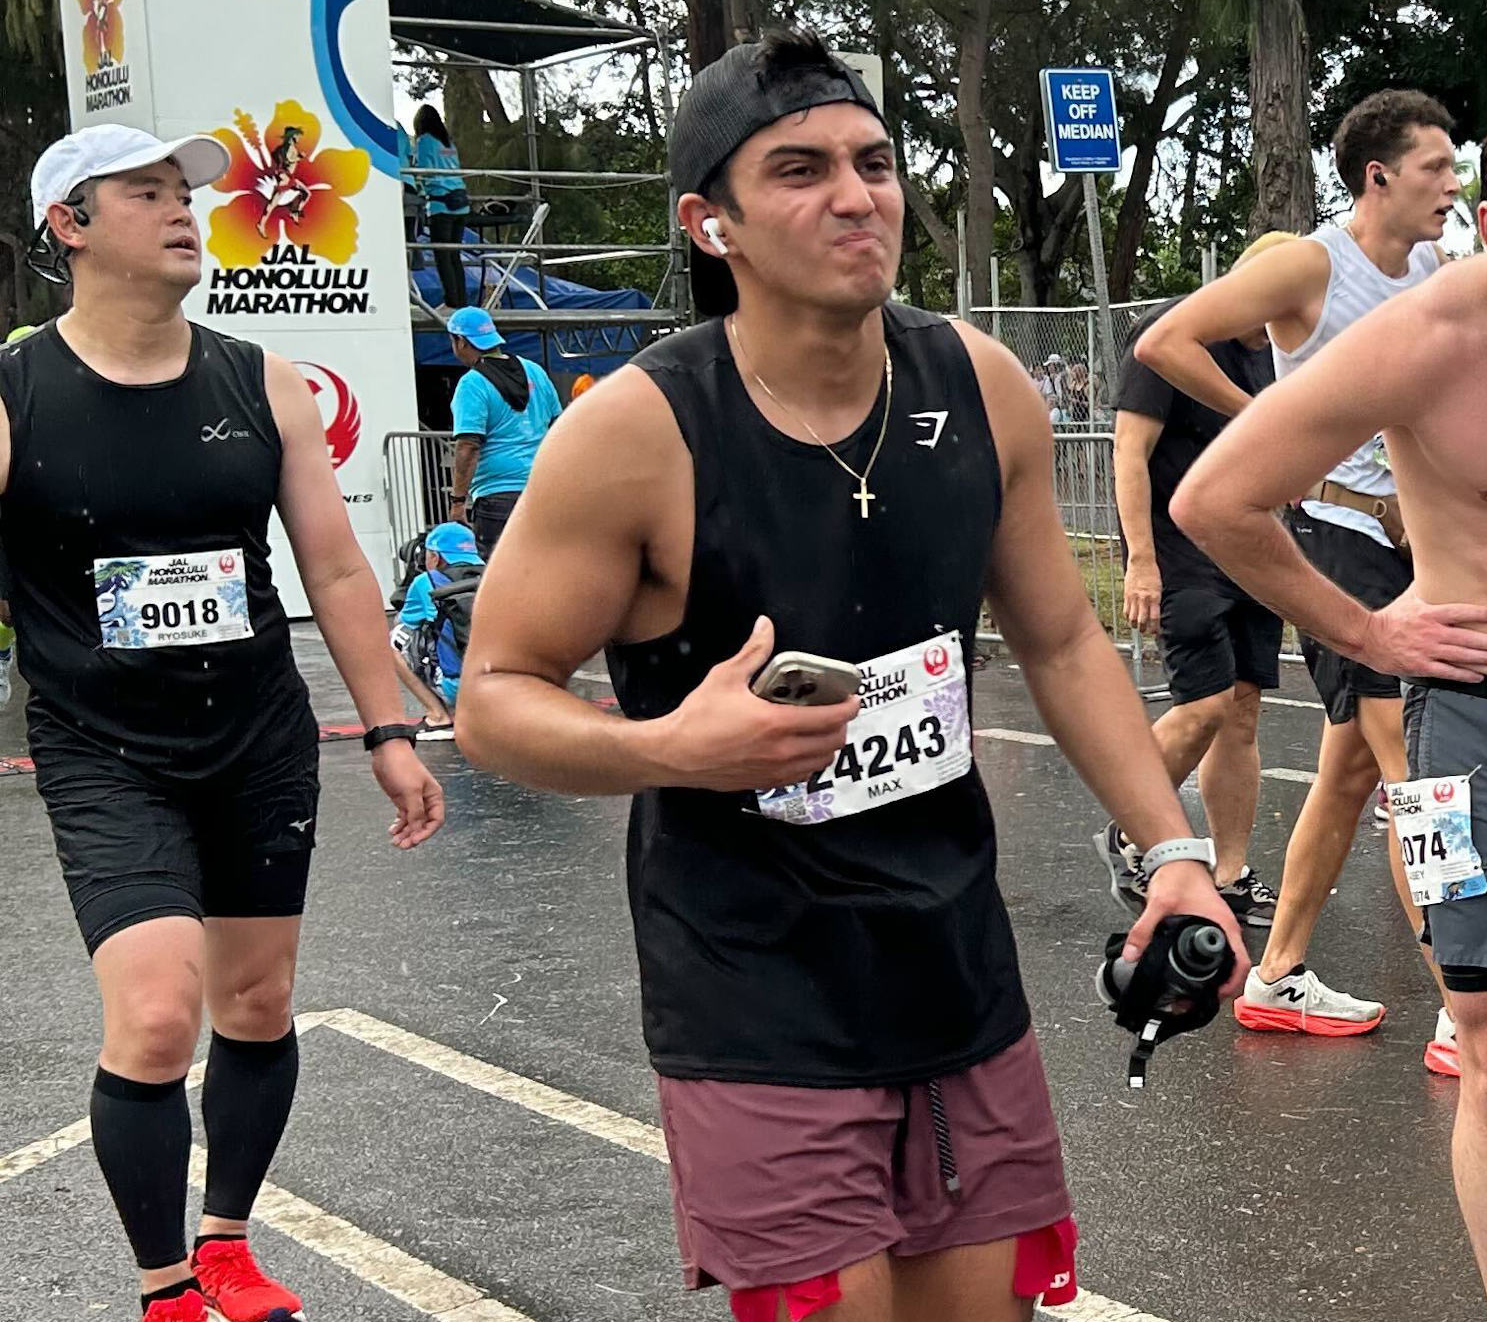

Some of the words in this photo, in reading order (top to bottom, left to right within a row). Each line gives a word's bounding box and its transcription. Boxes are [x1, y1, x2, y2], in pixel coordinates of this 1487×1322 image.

[86, 65, 129, 92] HONOLULU
[86, 85, 131, 112] MARATHON
[1061, 84, 1100, 100] KEEP
[1069, 104, 1097, 119] OFF
[1058, 124, 1114, 139] MEDIAN
[261, 244, 316, 265] JAL
[210, 268, 368, 289] HONOLULU
[207, 293, 369, 314] MARATHON
[149, 564, 208, 576] HONOLULU
[169, 558, 188, 567] JAL
[147, 573, 209, 586] MARATHON
[141, 598, 219, 629] 9018
[158, 629, 208, 641] RYOSUKE
[857, 669, 906, 696] OLULU
[860, 666, 877, 679] AL
[859, 684, 908, 709] ATHON
[867, 777, 903, 799] MAX
[1402, 831, 1447, 865] 074
